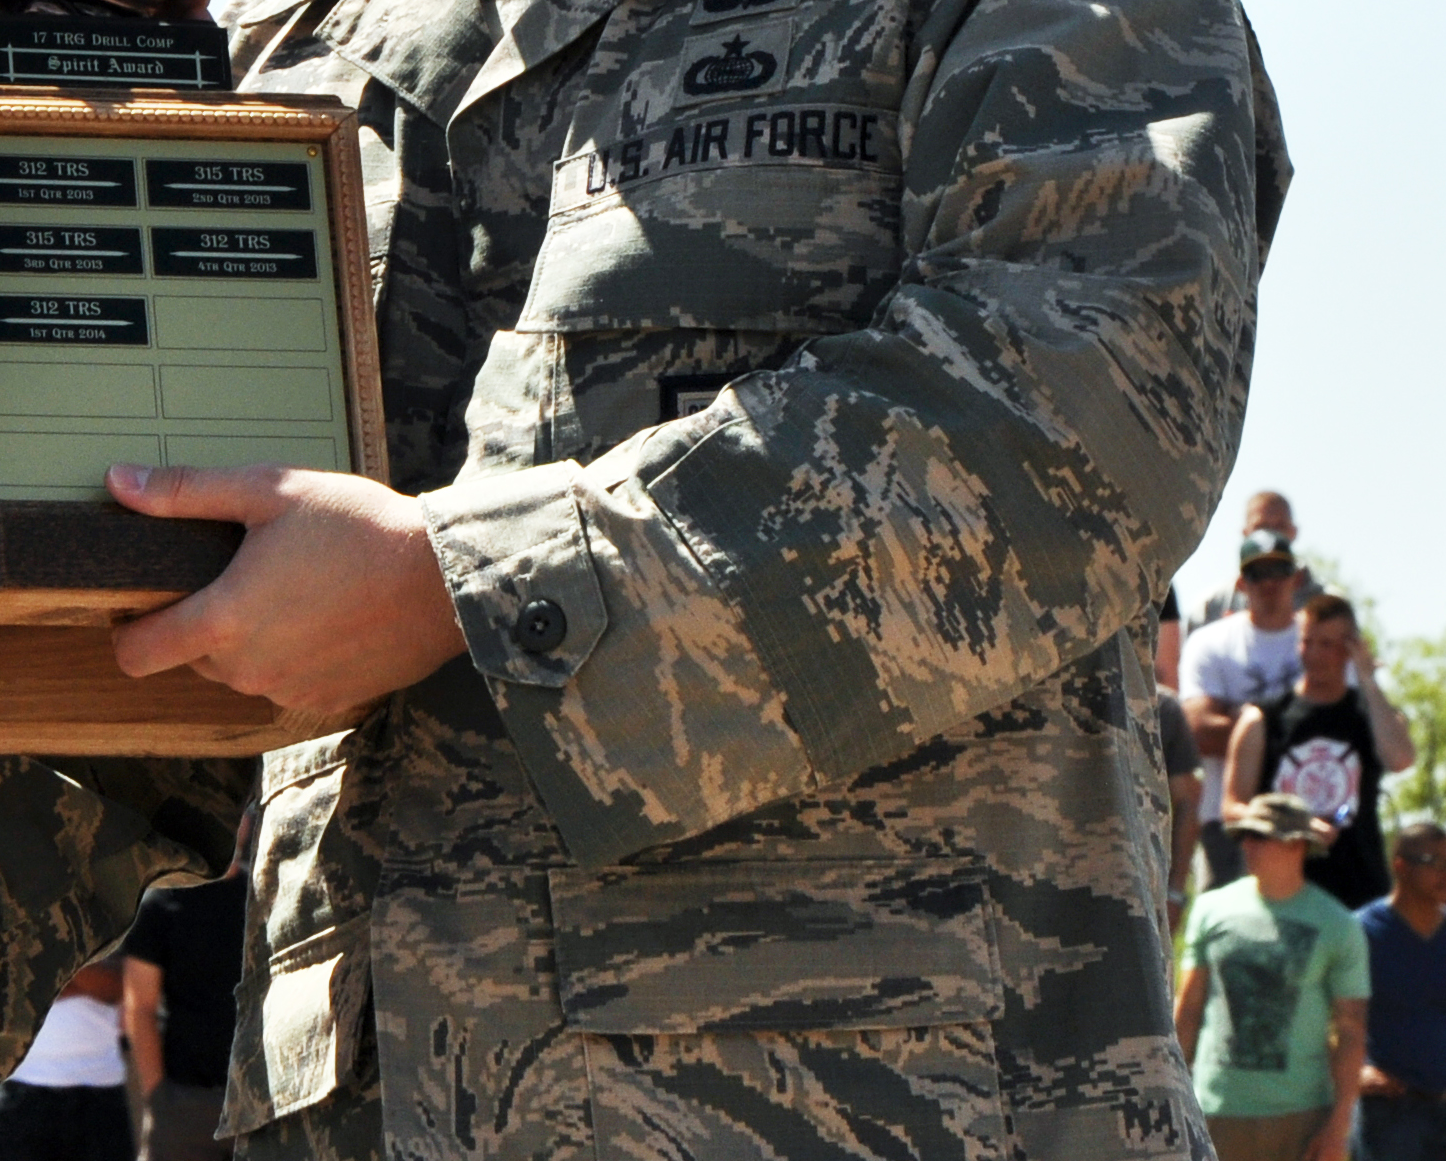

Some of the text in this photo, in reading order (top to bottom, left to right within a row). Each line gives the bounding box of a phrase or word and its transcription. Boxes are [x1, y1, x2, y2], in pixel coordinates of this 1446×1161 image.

[32, 31, 47, 44] 17
[54, 32, 85, 46] TRG
[47, 55, 164, 75] Spirit Award
[586, 109, 878, 195] U.S. AIR FORCE
[19, 161, 89, 177] 312 TRS
[194, 166, 265, 182] 315 TRS
[66, 189, 94, 200] 2013
[243, 194, 271, 205] 2013
[26, 231, 96, 247] 315 TRS
[200, 234, 271, 249] 312 TRS
[75, 259, 104, 270] 2013
[249, 262, 277, 273] 2013
[30, 300, 102, 316] 312 TRS
[79, 328, 106, 339] 2014
